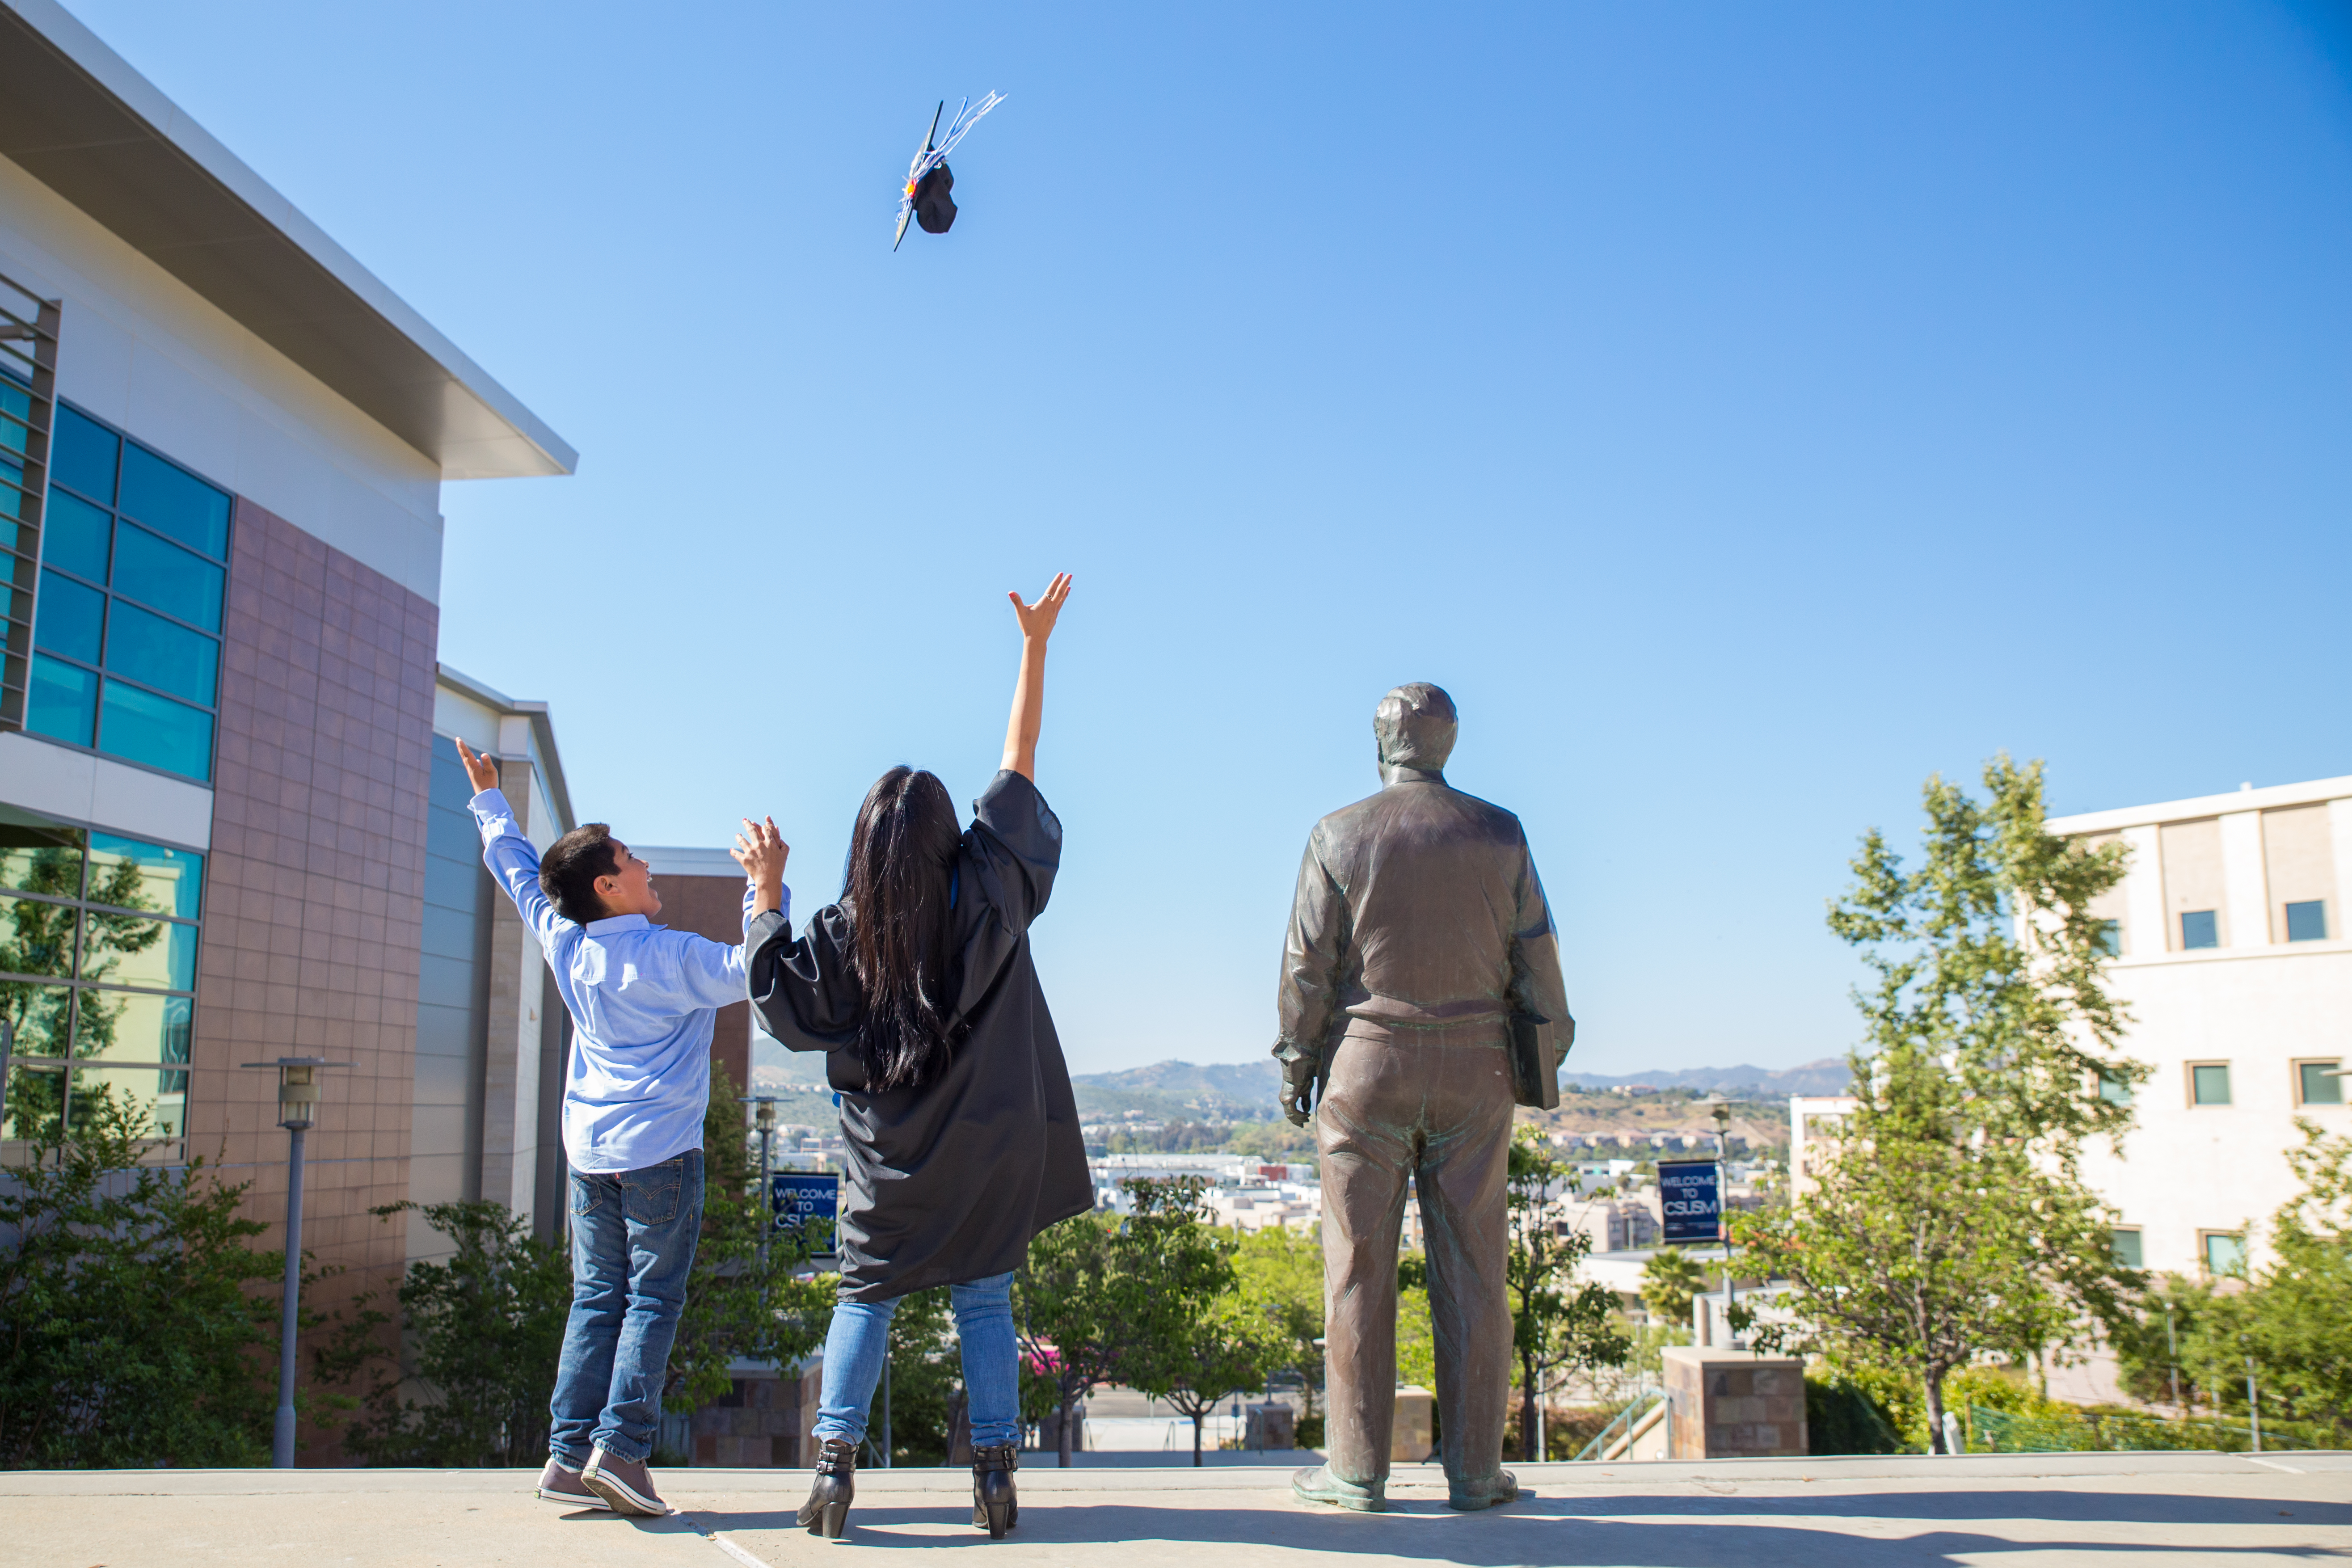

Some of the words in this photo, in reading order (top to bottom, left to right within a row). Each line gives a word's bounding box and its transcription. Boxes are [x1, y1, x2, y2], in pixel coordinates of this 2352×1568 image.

[1661, 1175, 1716, 1187] WELCOME
[1680, 1188, 1698, 1199] TO
[797, 1201, 814, 1212] TO
[1663, 1200, 1717, 1216] CSUSM
